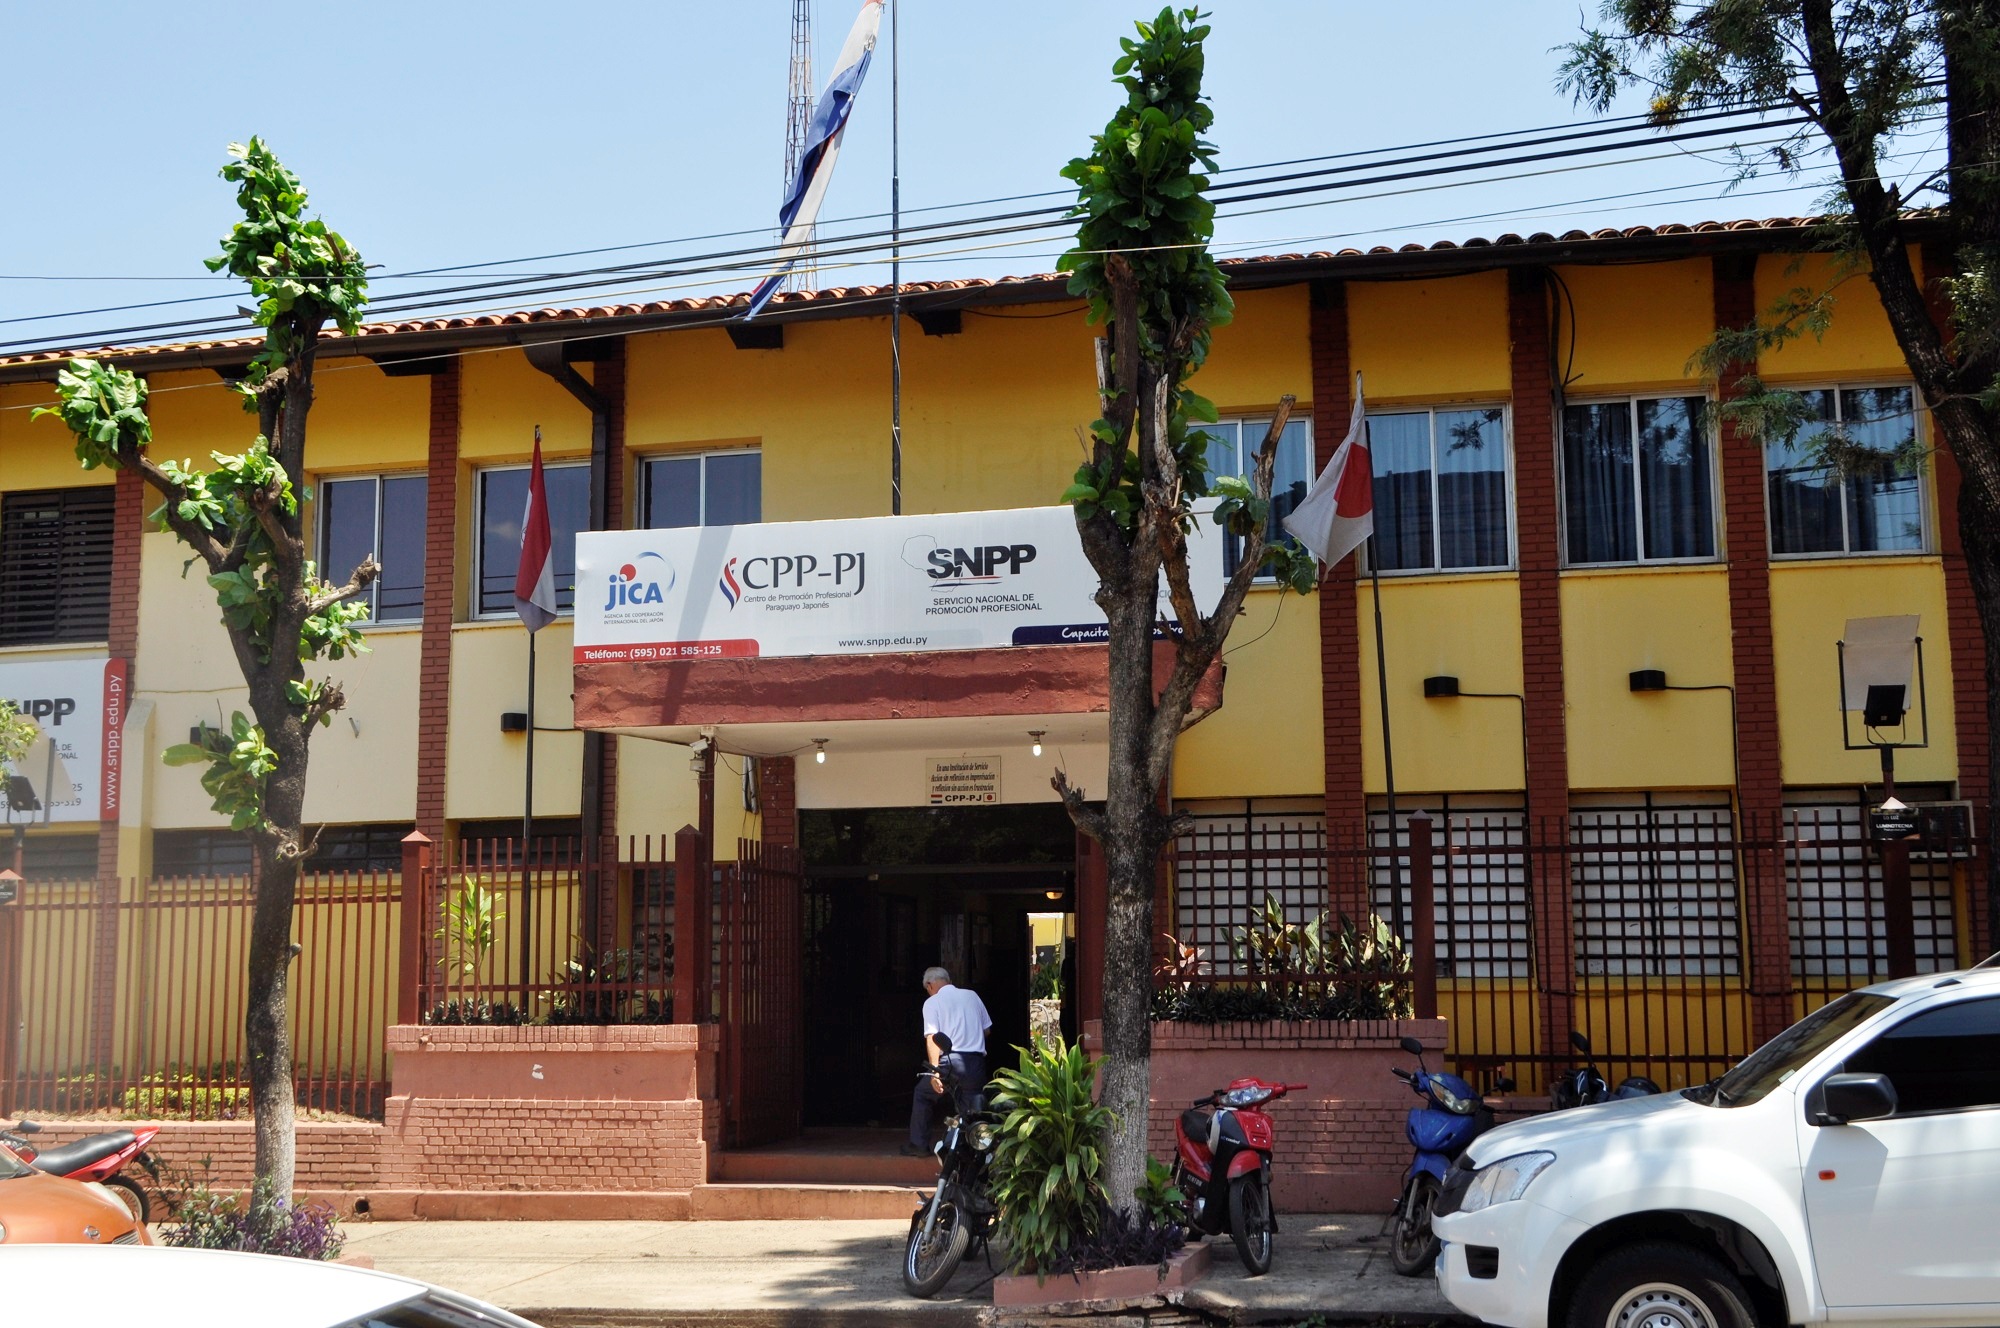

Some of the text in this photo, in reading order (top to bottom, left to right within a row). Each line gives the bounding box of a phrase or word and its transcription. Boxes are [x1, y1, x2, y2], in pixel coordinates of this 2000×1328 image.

[927, 543, 1037, 579] SNPP
[742, 552, 865, 595] CPP-PJ
[743, 590, 852, 603] Centro de Promoción Profesional
[933, 593, 1035, 606] SERVICIO NACIONAL DE
[765, 601, 830, 612] Paraguayo Japonés
[925, 602, 1043, 615] PROMOCIÓN PROFESIONAL
[838, 636, 928, 648] www.snpp.edu.py
[584, 645, 722, 659] Teléfono: (595) 021 585-125
[61, 743, 73, 751] DE
[106, 674, 123, 810] www.snpp.edu.py
[945, 794, 982, 802] CPP-PJ
